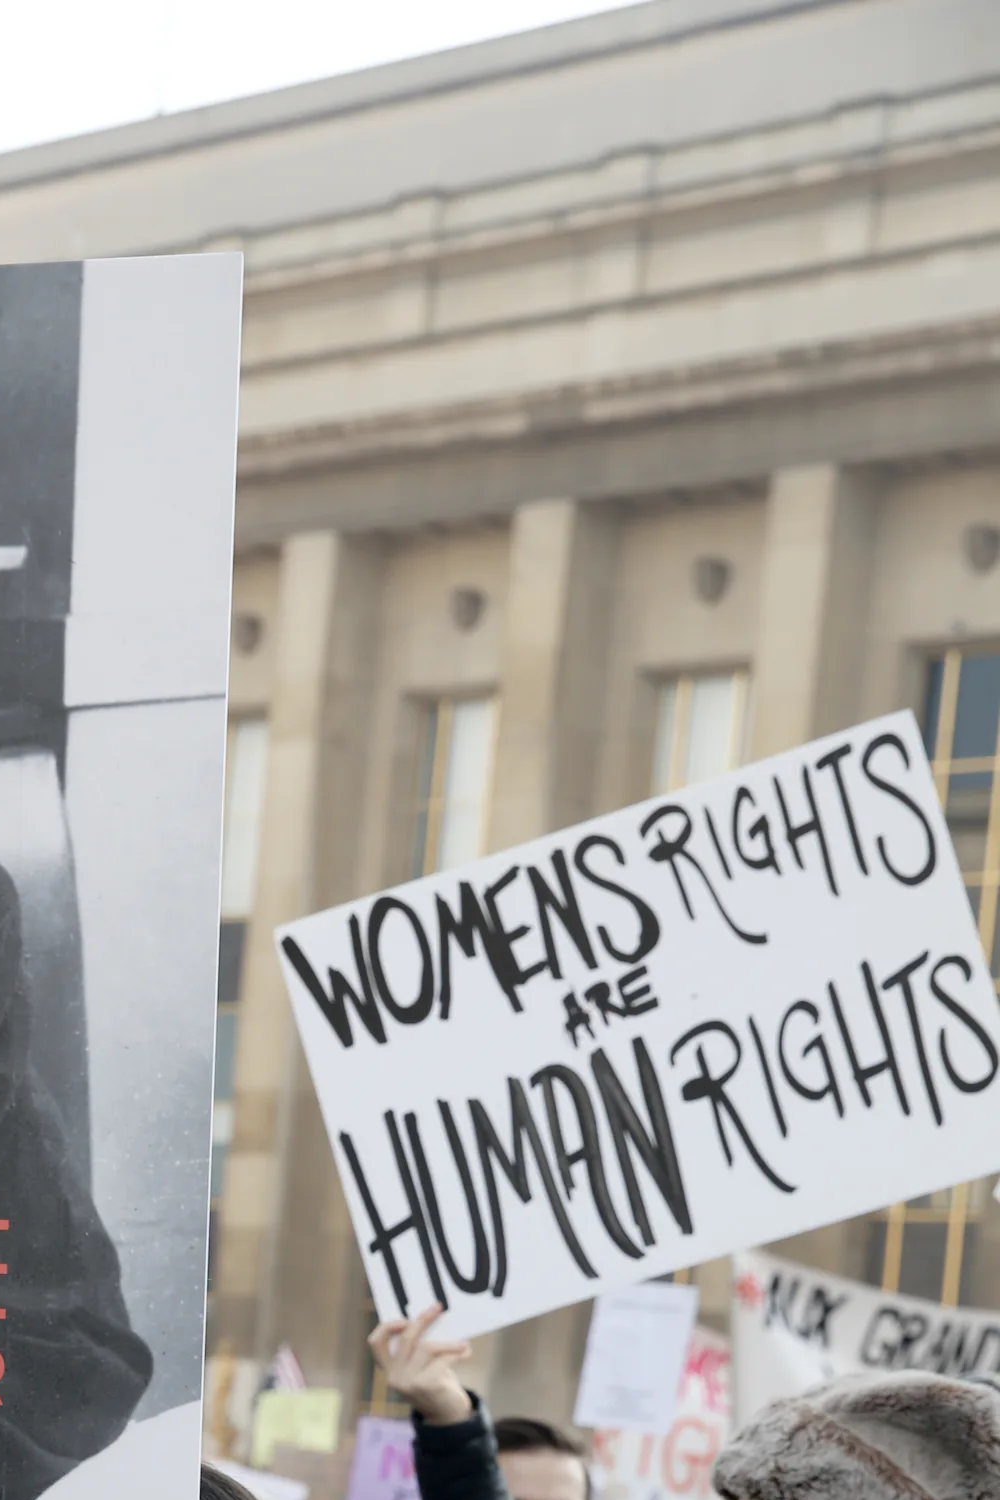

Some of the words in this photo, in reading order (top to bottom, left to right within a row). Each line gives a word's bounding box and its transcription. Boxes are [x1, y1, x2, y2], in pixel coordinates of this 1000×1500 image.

[281, 835, 660, 1048] WOMENS
[641, 733, 937, 944] RIGHTS
[562, 965, 659, 1048] ARE
[339, 1036, 693, 1320] HUMAN
[670, 951, 1000, 1193] RIGHTS
